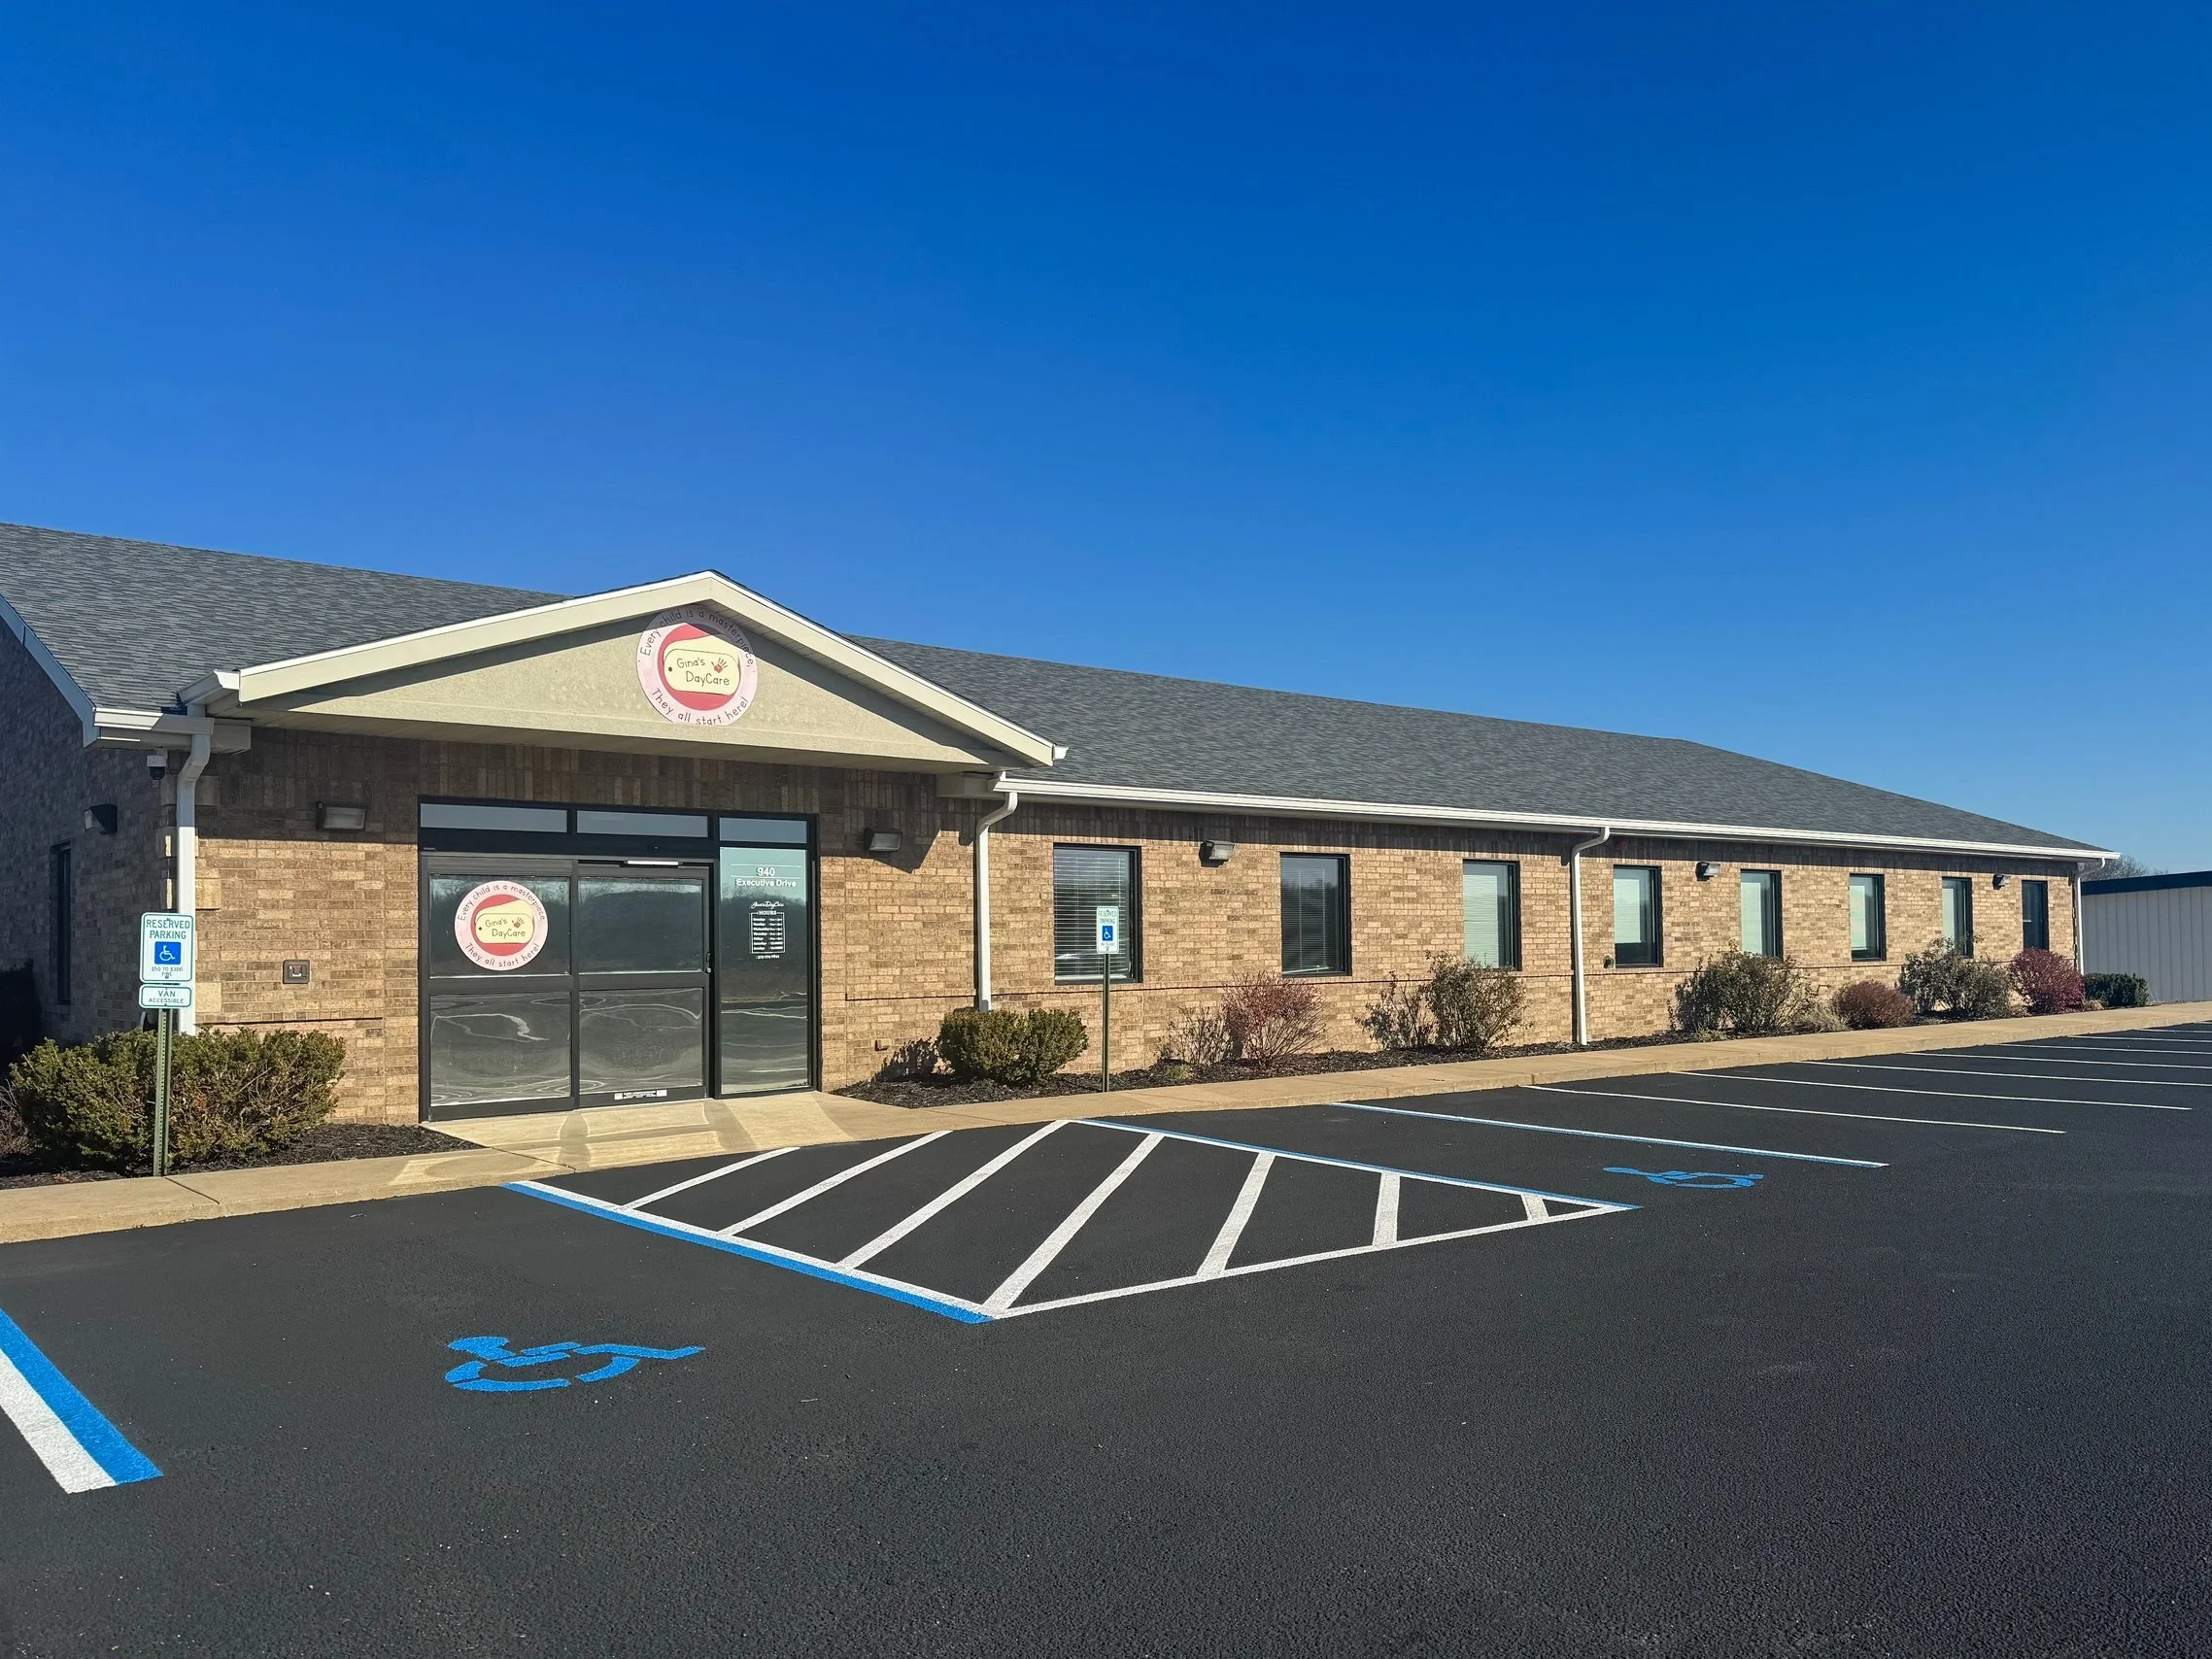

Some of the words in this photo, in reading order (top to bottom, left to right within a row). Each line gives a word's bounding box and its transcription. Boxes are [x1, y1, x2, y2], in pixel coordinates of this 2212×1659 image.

[639, 628, 662, 656] Every
[660, 608, 682, 627] child
[686, 609, 695, 618] is
[677, 657, 706, 668] Gina's
[686, 670, 731, 687] DayCare
[651, 688, 674, 715] They
[678, 712, 691, 722] all
[696, 715, 722, 726] start
[725, 696, 749, 720] here!
[757, 866, 775, 876] 940
[735, 878, 774, 887] Executive
[457, 899, 475, 921] Every
[472, 886, 491, 900] child
[146, 919, 190, 929] RESERVED
[485, 918, 508, 928] Gina's
[150, 930, 187, 939] PARKING
[492, 928, 526, 939] DayCare
[465, 942, 483, 962] They
[498, 959, 519, 967] start
[521, 943, 540, 962] here!
